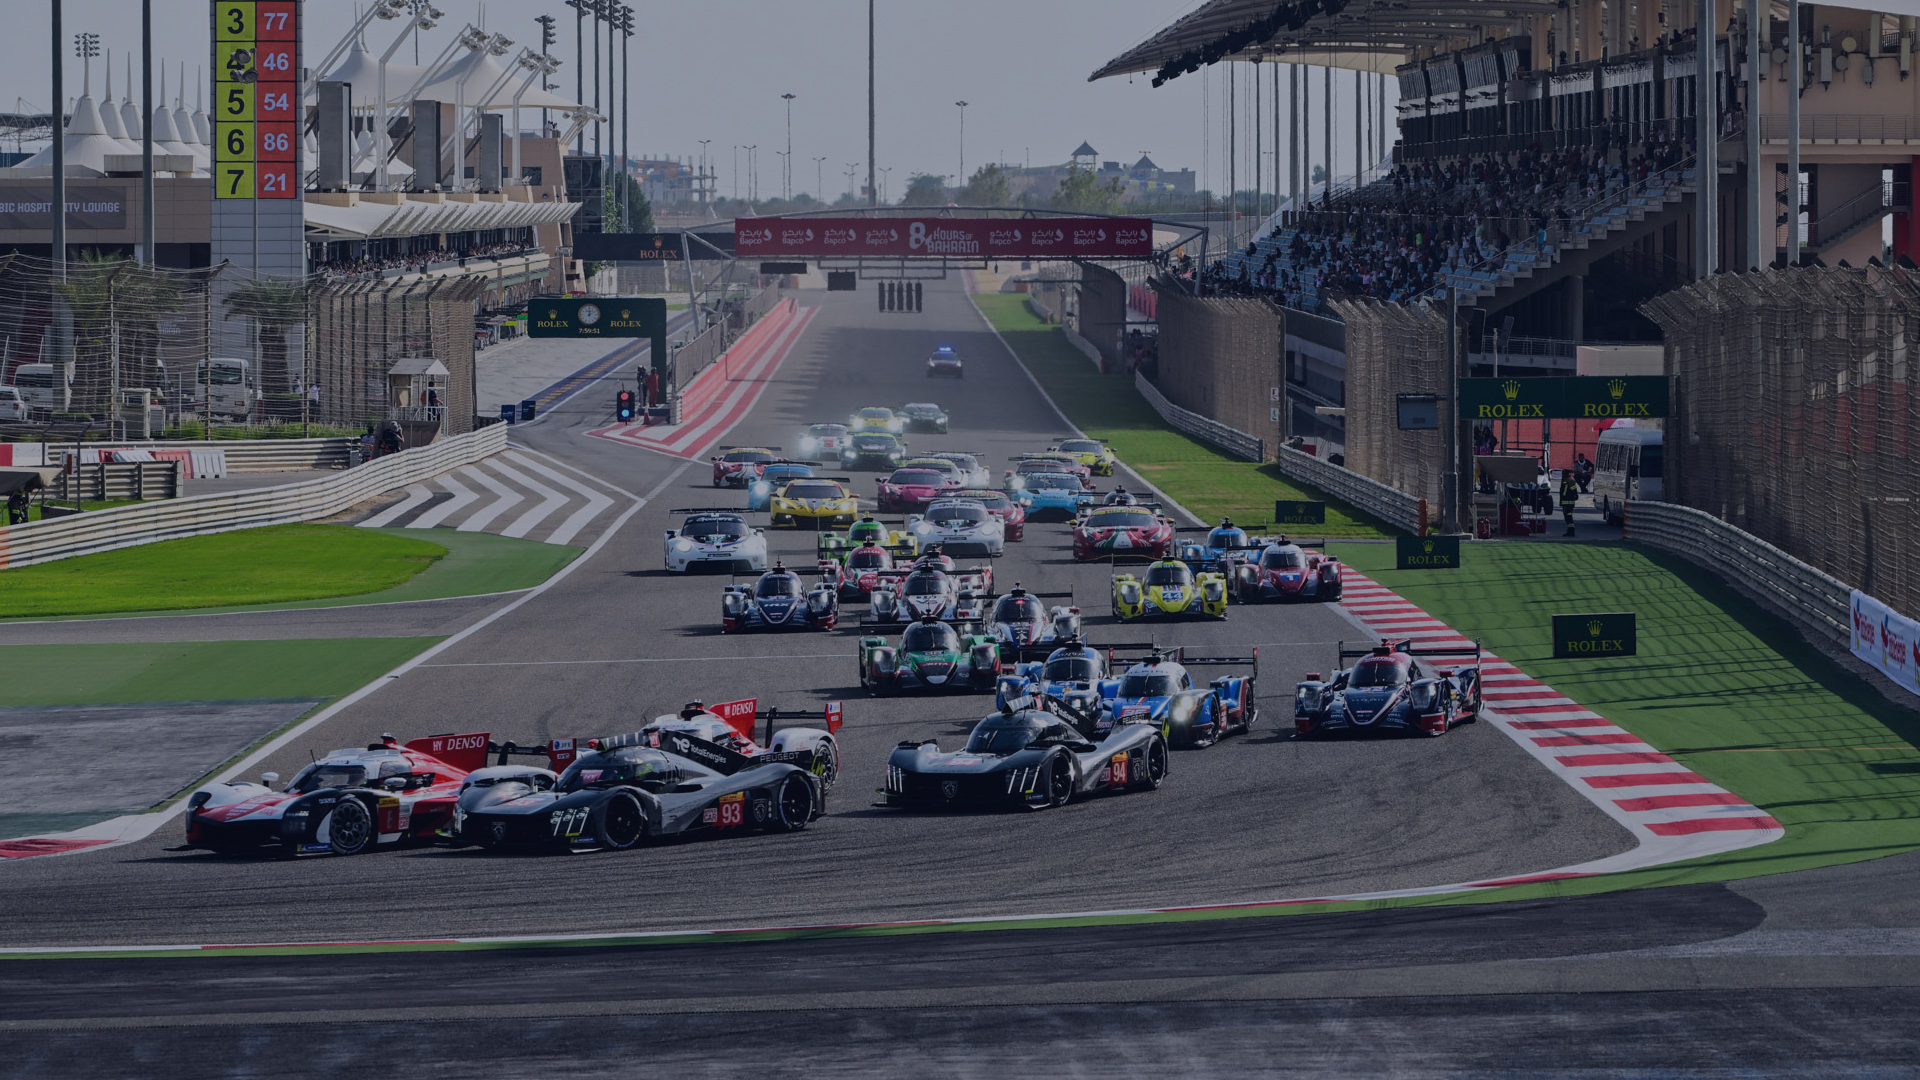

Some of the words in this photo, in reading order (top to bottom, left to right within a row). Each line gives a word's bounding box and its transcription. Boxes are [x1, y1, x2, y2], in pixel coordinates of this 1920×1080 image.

[227, 8, 244, 34] 3
[263, 12, 289, 31] 77
[263, 52, 289, 71] 46
[227, 89, 245, 115] 5
[263, 93, 289, 111] 54
[227, 128, 245, 155] 6
[263, 133, 289, 151] 86
[227, 169, 245, 194] 7
[263, 173, 286, 191] 21
[17, 202, 80, 213] HOSPITITY
[82, 202, 120, 213] LOUNGE
[739, 238, 762, 246] Bapco
[909, 222, 926, 249] 8
[933, 227, 965, 240] HOURS
[989, 238, 1012, 246] Bapco
[1032, 238, 1053, 246] Bapco
[1074, 238, 1096, 246] Bapco
[1116, 238, 1138, 246] Bapco
[927, 240, 979, 253] BAHRAIN
[640, 249, 677, 259] ROLEX
[537, 320, 569, 328] ROLEX
[610, 320, 642, 328] ROLEX
[1478, 404, 1545, 418] ROLEX
[1583, 403, 1650, 417] ROLEX
[1284, 515, 1317, 523] ROLEX
[1408, 555, 1450, 565] ROLEX
[1567, 639, 1625, 652] ROLEX
[731, 702, 754, 716] DENSO
[432, 740, 443, 751] HY
[447, 736, 485, 750] DENSO
[690, 744, 727, 763] TotalEnergies
[760, 752, 800, 763] PEUGEOT
[1113, 762, 1126, 782] 94
[722, 803, 741, 823] 93
